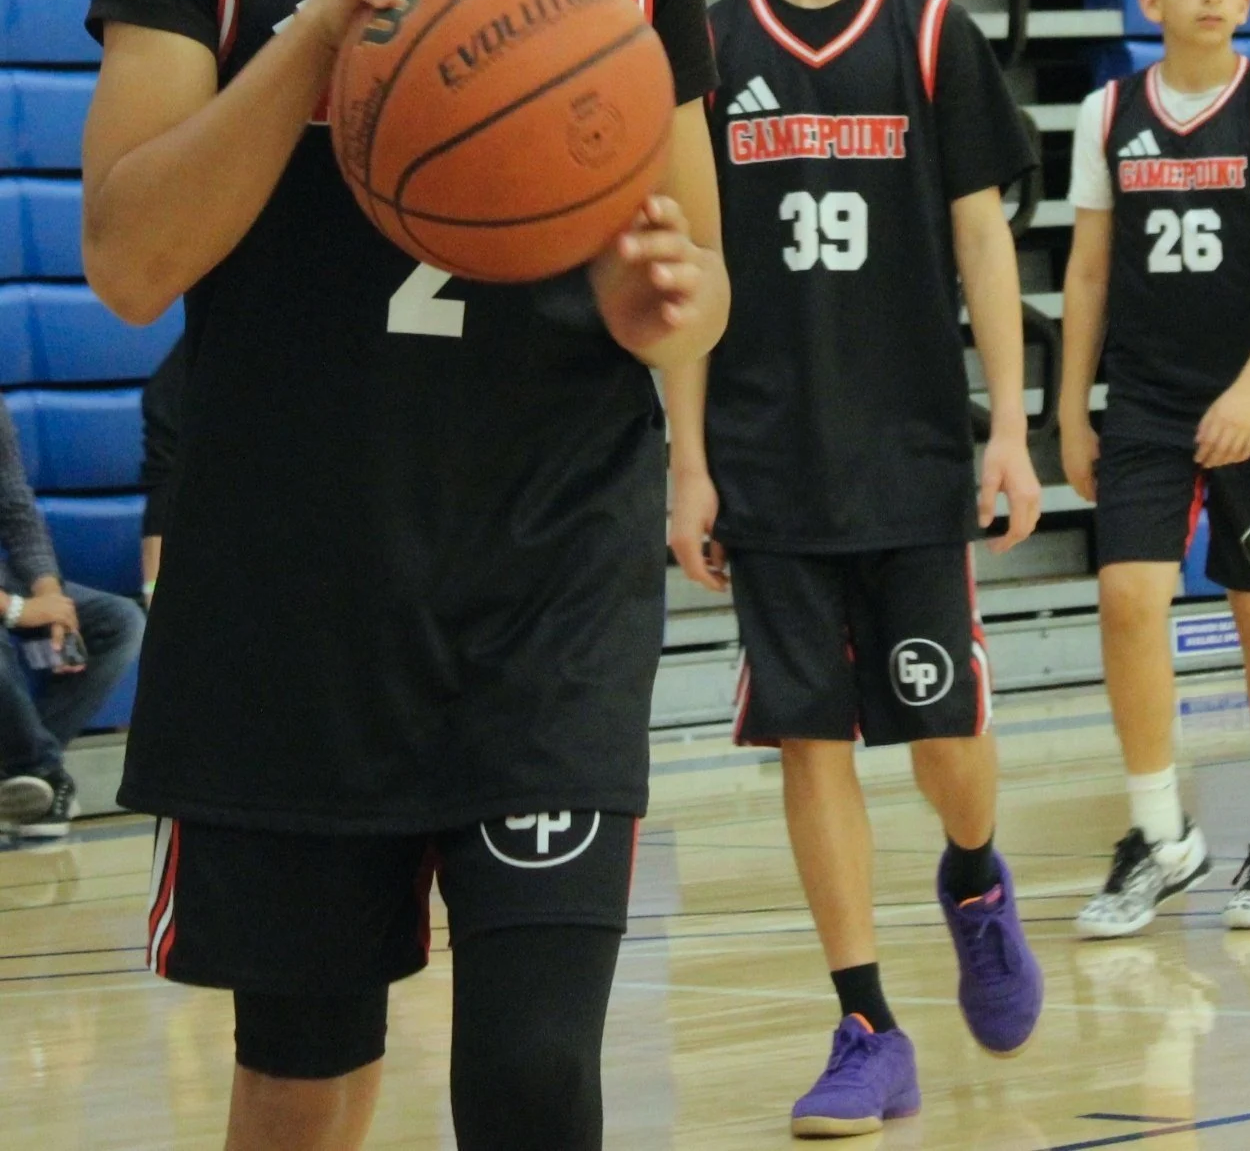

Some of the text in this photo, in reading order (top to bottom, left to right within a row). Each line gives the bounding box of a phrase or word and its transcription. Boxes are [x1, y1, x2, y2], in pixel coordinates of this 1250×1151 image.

[728, 114, 909, 164] GAMEPOINT
[1119, 156, 1248, 192] GAMEPOINT
[779, 191, 868, 271] 39
[1145, 208, 1223, 273] 26
[898, 650, 938, 697] GP
